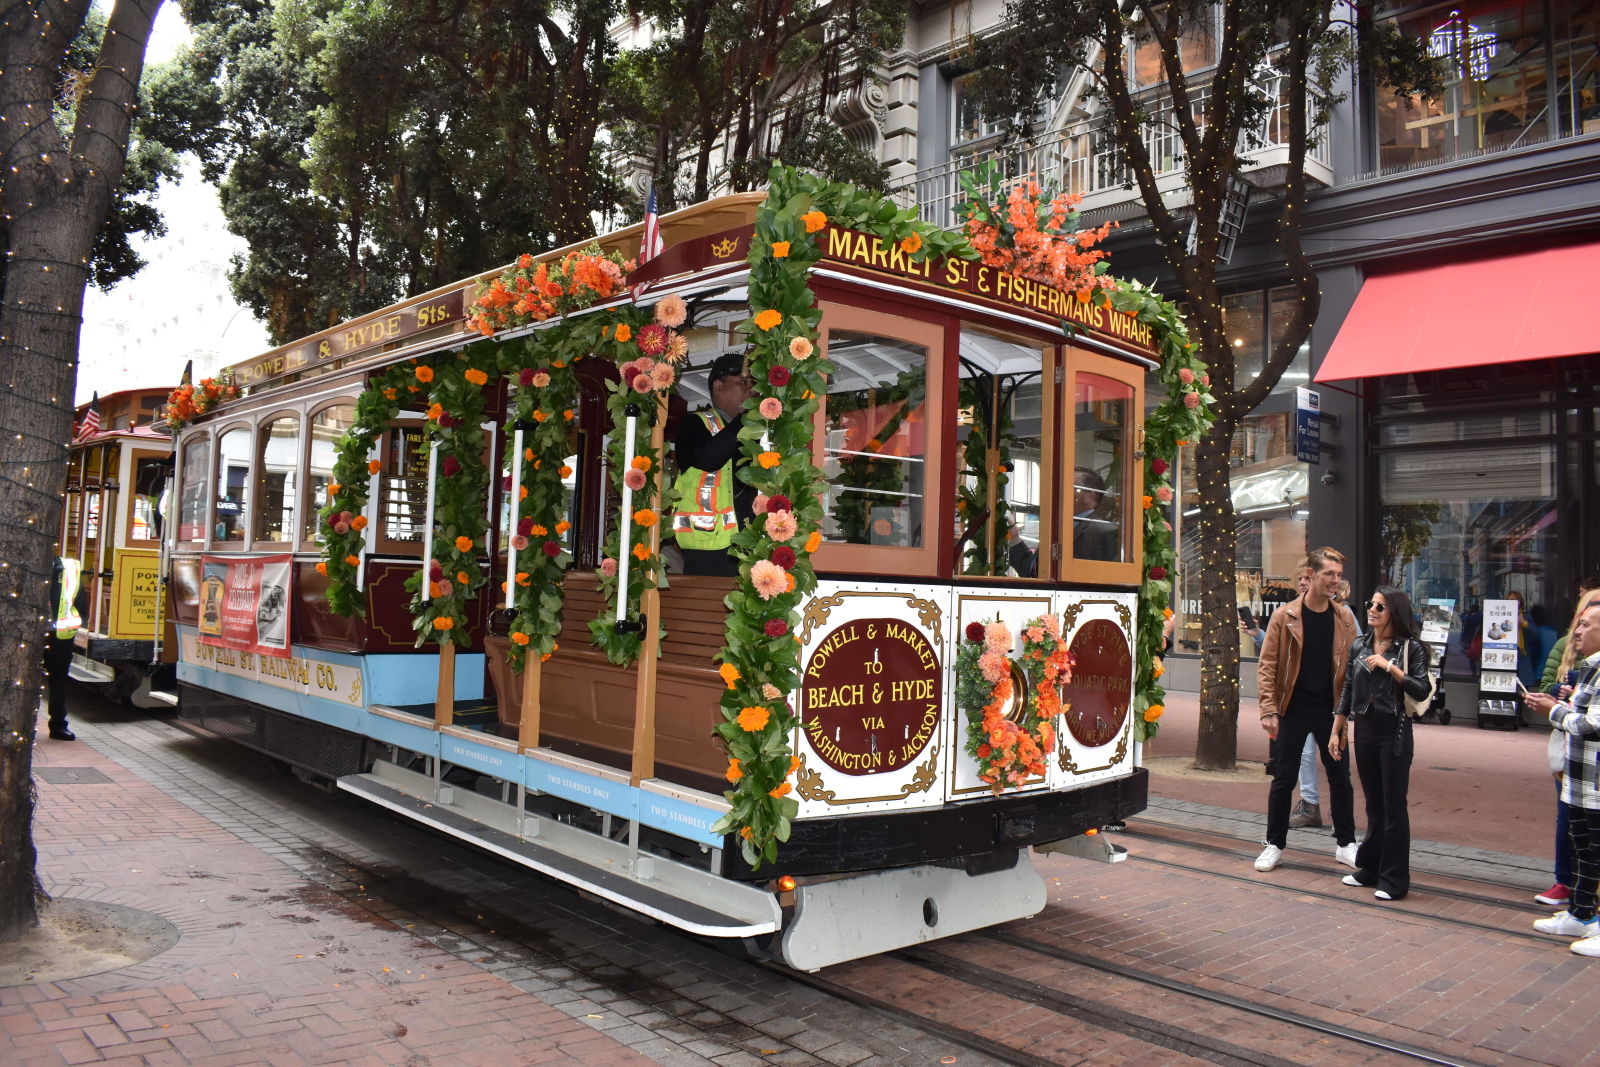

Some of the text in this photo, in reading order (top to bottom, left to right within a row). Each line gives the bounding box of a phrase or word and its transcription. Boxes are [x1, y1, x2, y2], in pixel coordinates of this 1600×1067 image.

[997, 276, 1104, 328] FISHERMANS
[1109, 309, 1153, 346] WHARF
[242, 304, 451, 383] POWELL & HYDE Sts.
[406, 433, 421, 443] FARE
[1298, 425, 1319, 438] For Lease
[808, 623, 936, 678] POWELL & MARKET
[260, 655, 310, 685] RAILWAY
[316, 663, 337, 691] CO.
[864, 661, 884, 675] TO
[808, 679, 935, 709] BEACH & HYDE
[1073, 674, 1106, 691] QUATIC
[808, 703, 938, 769] WASHINGTON & JACKSON
[861, 717, 886, 730] VIA
[464, 749, 490, 764] STANDEES
[489, 756, 503, 767] ONLY
[547, 774, 610, 799] TWO STANDEES ONLY
[651, 805, 668, 818] TWO
[669, 809, 706, 830] STANDEES
